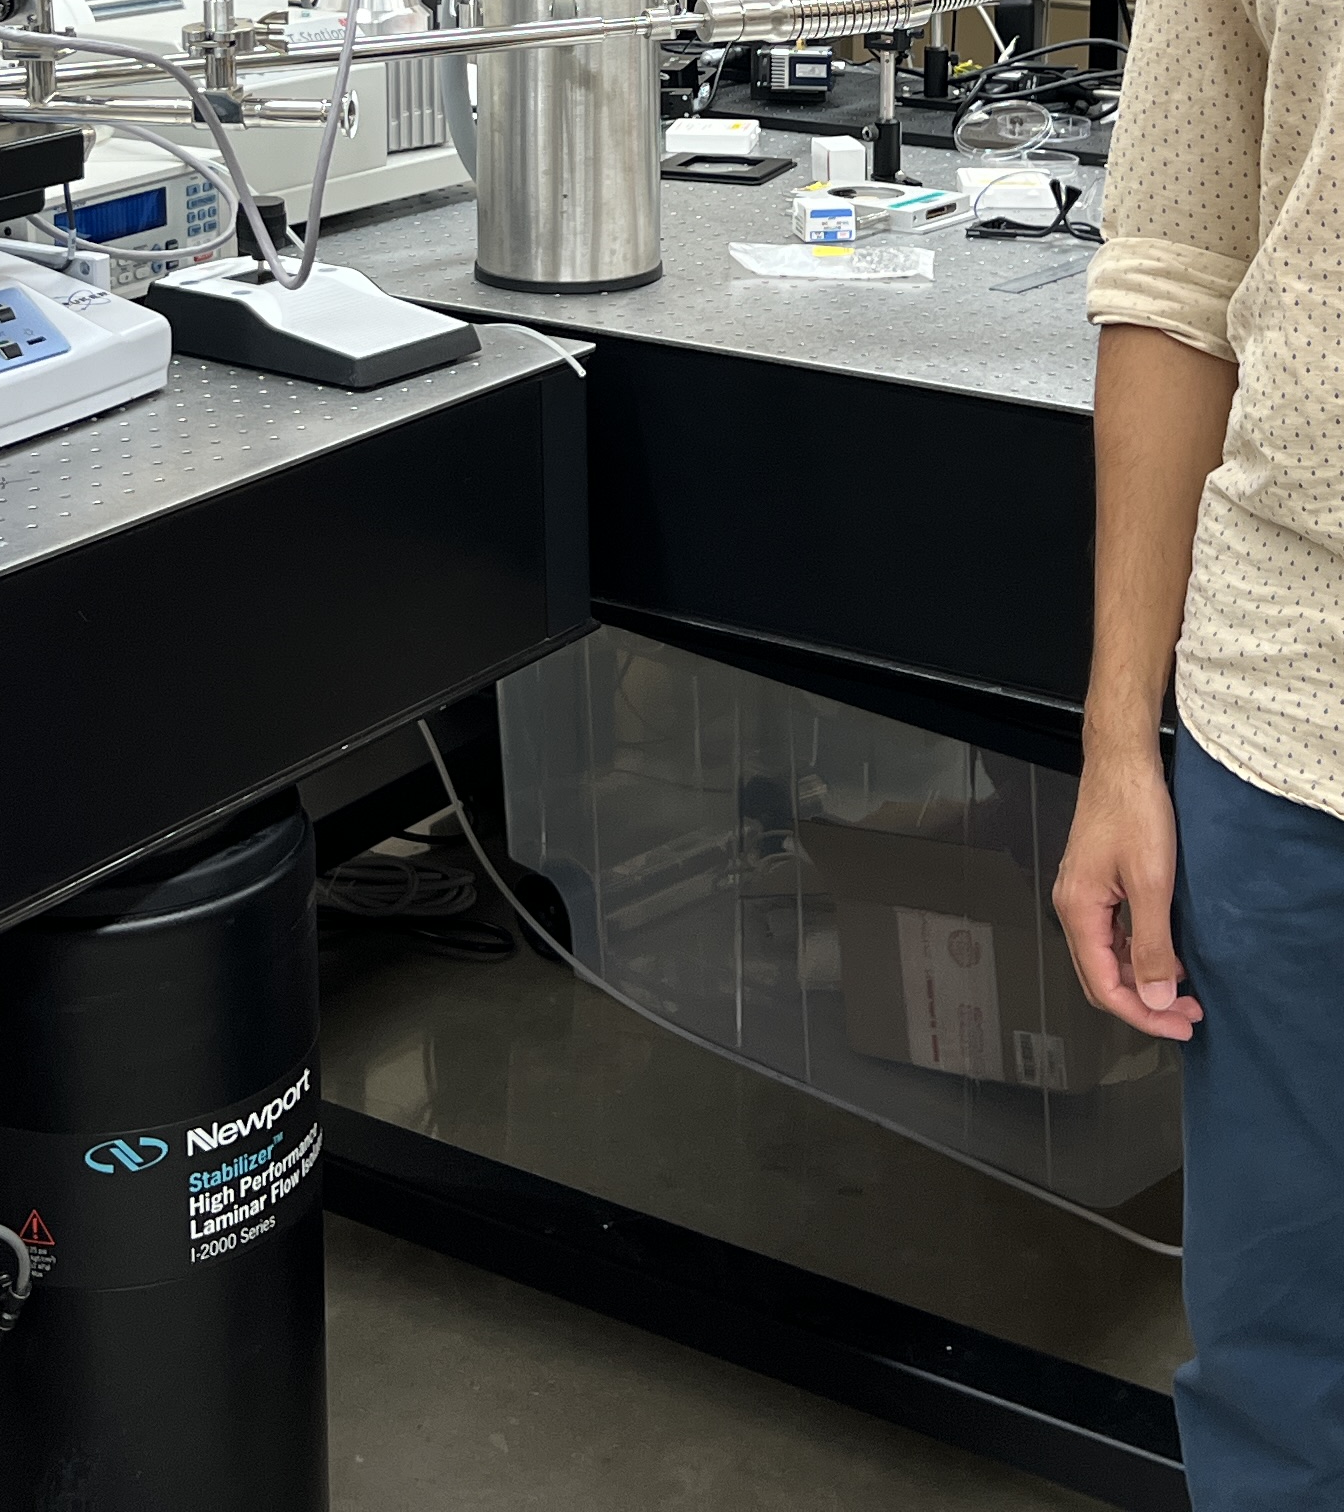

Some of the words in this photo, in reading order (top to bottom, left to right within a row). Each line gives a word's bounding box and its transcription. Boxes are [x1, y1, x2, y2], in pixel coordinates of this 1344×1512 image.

[187, 1067, 311, 1157] Newport
[189, 1186, 235, 1216] High
[190, 1193, 267, 1240] Laminar
[270, 1170, 300, 1204] Flow
[240, 1215, 276, 1244] Series
